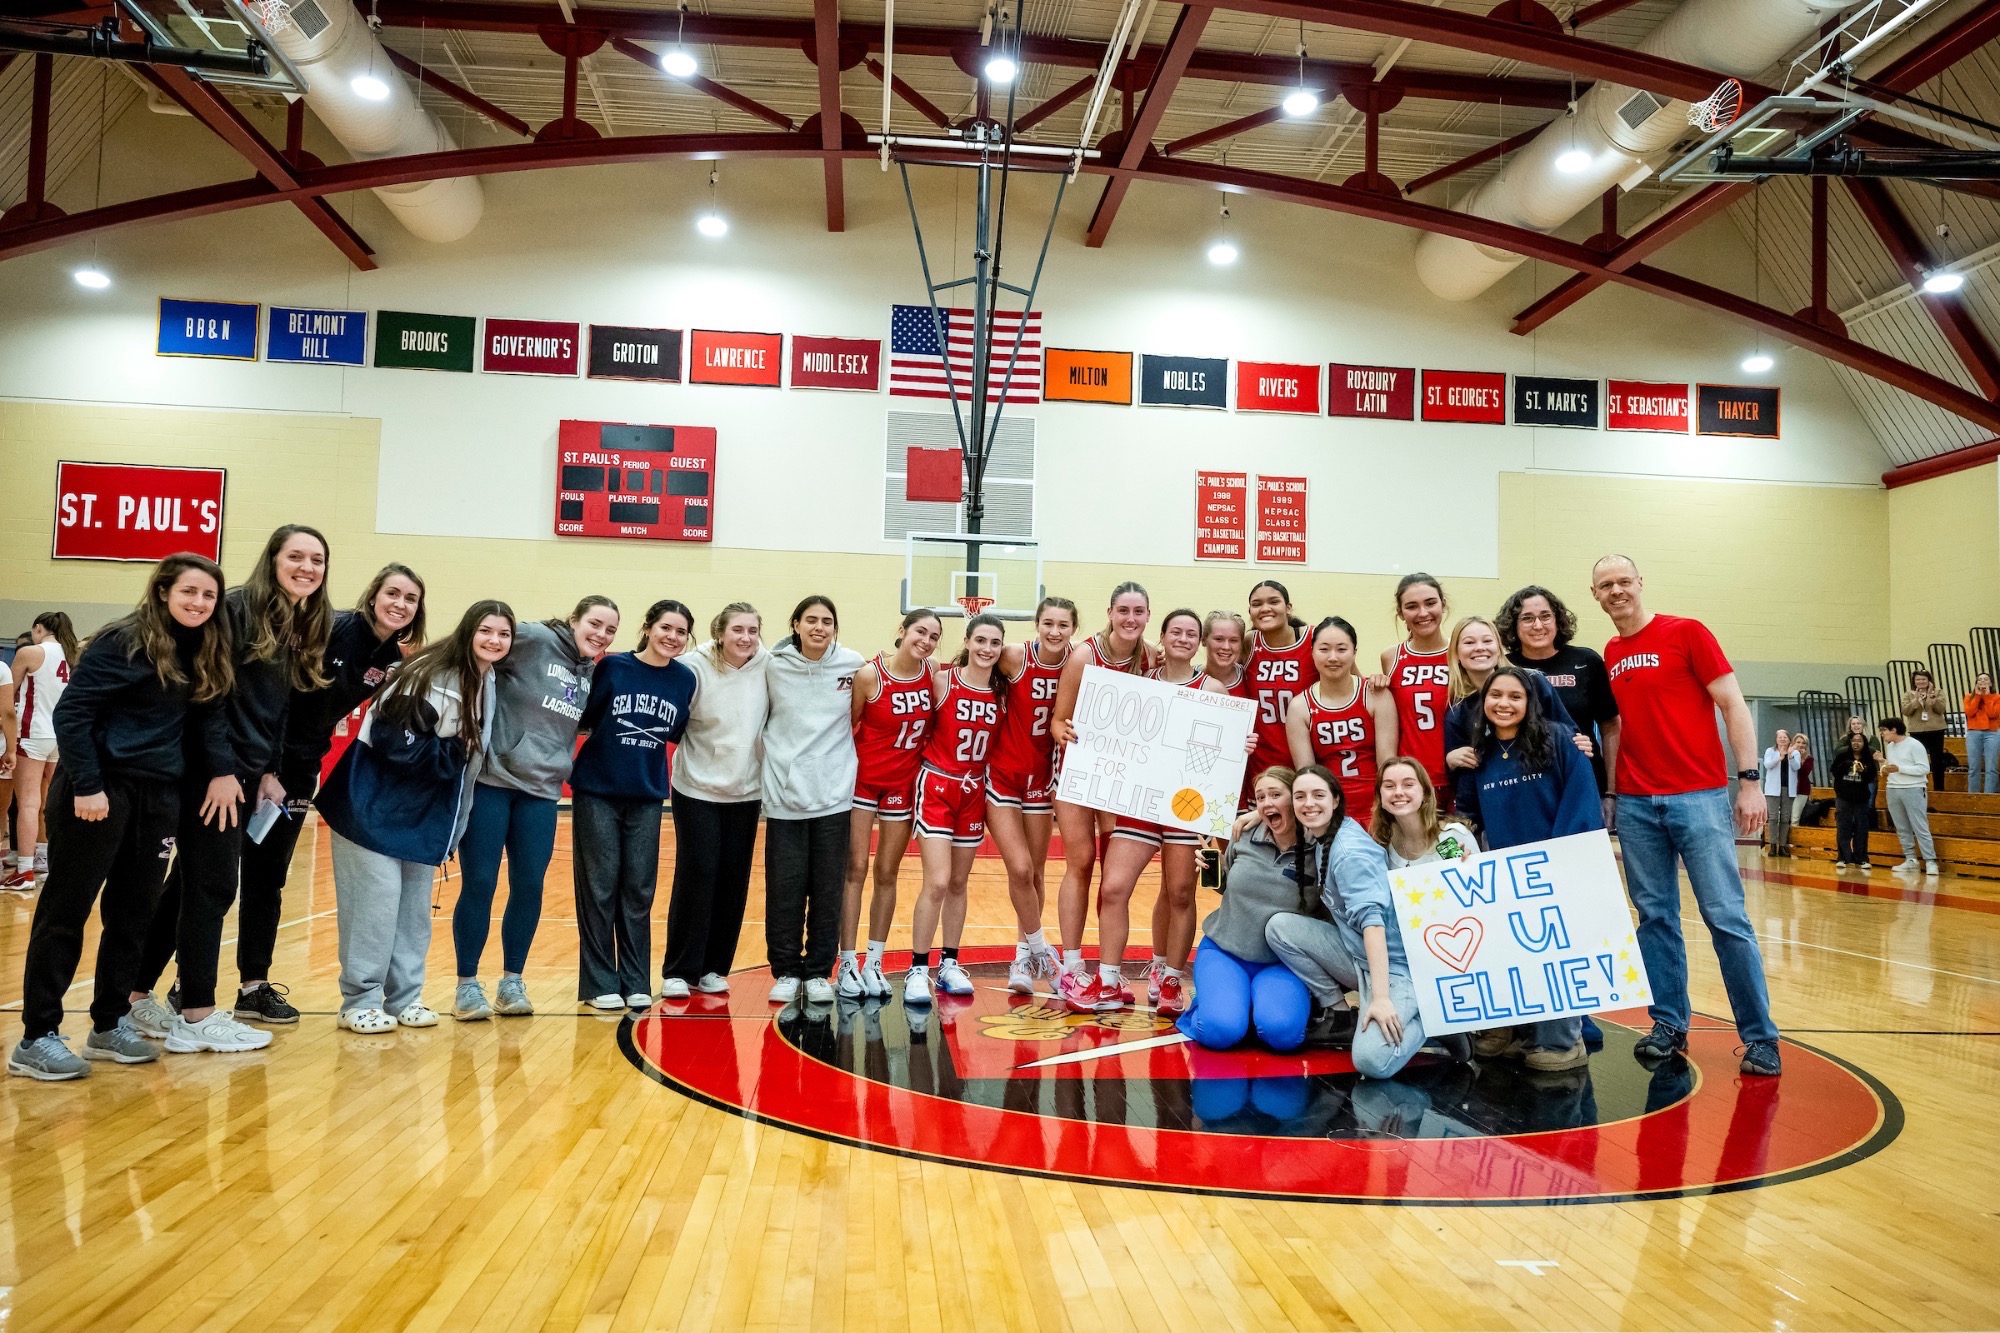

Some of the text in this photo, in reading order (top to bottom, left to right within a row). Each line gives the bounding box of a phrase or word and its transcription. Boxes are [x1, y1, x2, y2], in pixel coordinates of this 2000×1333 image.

[185, 317, 231, 341] BB&N
[289, 313, 347, 336] BELMONT
[302, 337, 329, 358] HILL
[401, 330, 448, 353] BROOKS
[492, 335, 571, 359] GOVERNOR'S
[613, 342, 659, 365] GROTON
[705, 347, 766, 369] LAWRENCE
[802, 353, 869, 375] MIDDLESEX
[1069, 366, 1108, 387] MILTON
[1163, 371, 1206, 392] NOBLES
[1347, 369, 1397, 392] ROXBURY
[1259, 377, 1298, 398] RIVERS
[1428, 386, 1500, 408] ST. GEORGE'S
[1356, 393, 1387, 413] LATIN
[1525, 391, 1588, 413] ST. MARK'S
[1609, 395, 1688, 418] ST. SEBASTIAN'S
[1718, 401, 1759, 421] THAYER
[563, 452, 620, 465] ST. PAUL'S
[623, 461, 650, 469] PERIOD
[670, 457, 706, 469] GUEST
[1207, 477, 1225, 488] PAUL'S
[1226, 478, 1246, 488] SCHOOL
[1267, 481, 1284, 492] PAUL'S
[1286, 482, 1306, 492] SCHOOL
[560, 493, 585, 501] FOULS
[608, 494, 661, 505] PLAYER FOUL
[684, 498, 709, 507] FOULS
[1272, 496, 1293, 504] 1989
[61, 493, 217, 533] ST. PAUL'S
[1207, 504, 1236, 512] NEPSAC
[1265, 508, 1299, 516] NEPSAC
[558, 523, 584, 532] SCORE
[620, 526, 647, 535] MATCH
[1205, 516, 1229, 524] CLASS
[1265, 519, 1291, 527] CLASS
[682, 529, 708, 537] SCORE
[1198, 528, 1245, 540] BOYS BASKETBALL
[1258, 531, 1305, 542] BOYS BASKETBALL
[1203, 543, 1239, 554] CHAMPIONS
[1263, 546, 1300, 557] CHAMPIONS
[56, 660, 70, 684] 4
[1256, 660, 1300, 682] SPS
[1401, 665, 1449, 686] SPS
[1610, 653, 1660, 681] ST. PAUL'S
[1031, 677, 1059, 700] SP
[612, 693, 678, 727] SEA ISLE CITY
[891, 689, 931, 715] SPS
[1177, 690, 1250, 711] #24 CAN SCORE!
[1258, 689, 1295, 724] 50
[1413, 691, 1436, 731] 5
[955, 699, 997, 725] SPS
[1031, 706, 1049, 736] 2
[1078, 682, 1164, 742] 1000
[621, 737, 637, 746] NEW
[894, 719, 926, 750] 12
[1316, 717, 1365, 745] SPS
[956, 728, 990, 762] 20
[1083, 732, 1150, 764] POINTS
[1094, 757, 1127, 780] FOR
[1339, 750, 1360, 777] 2
[1483, 773, 1542, 790] NEW YORK CITY
[887, 796, 902, 805] SPS
[1027, 790, 1043, 799] SPS
[1061, 768, 1165, 821] ELLIE
[969, 823, 982, 831] SPS
[1441, 850, 1554, 908] WE
[1508, 905, 1571, 953] U
[1435, 954, 1619, 1023] ELLIE!
